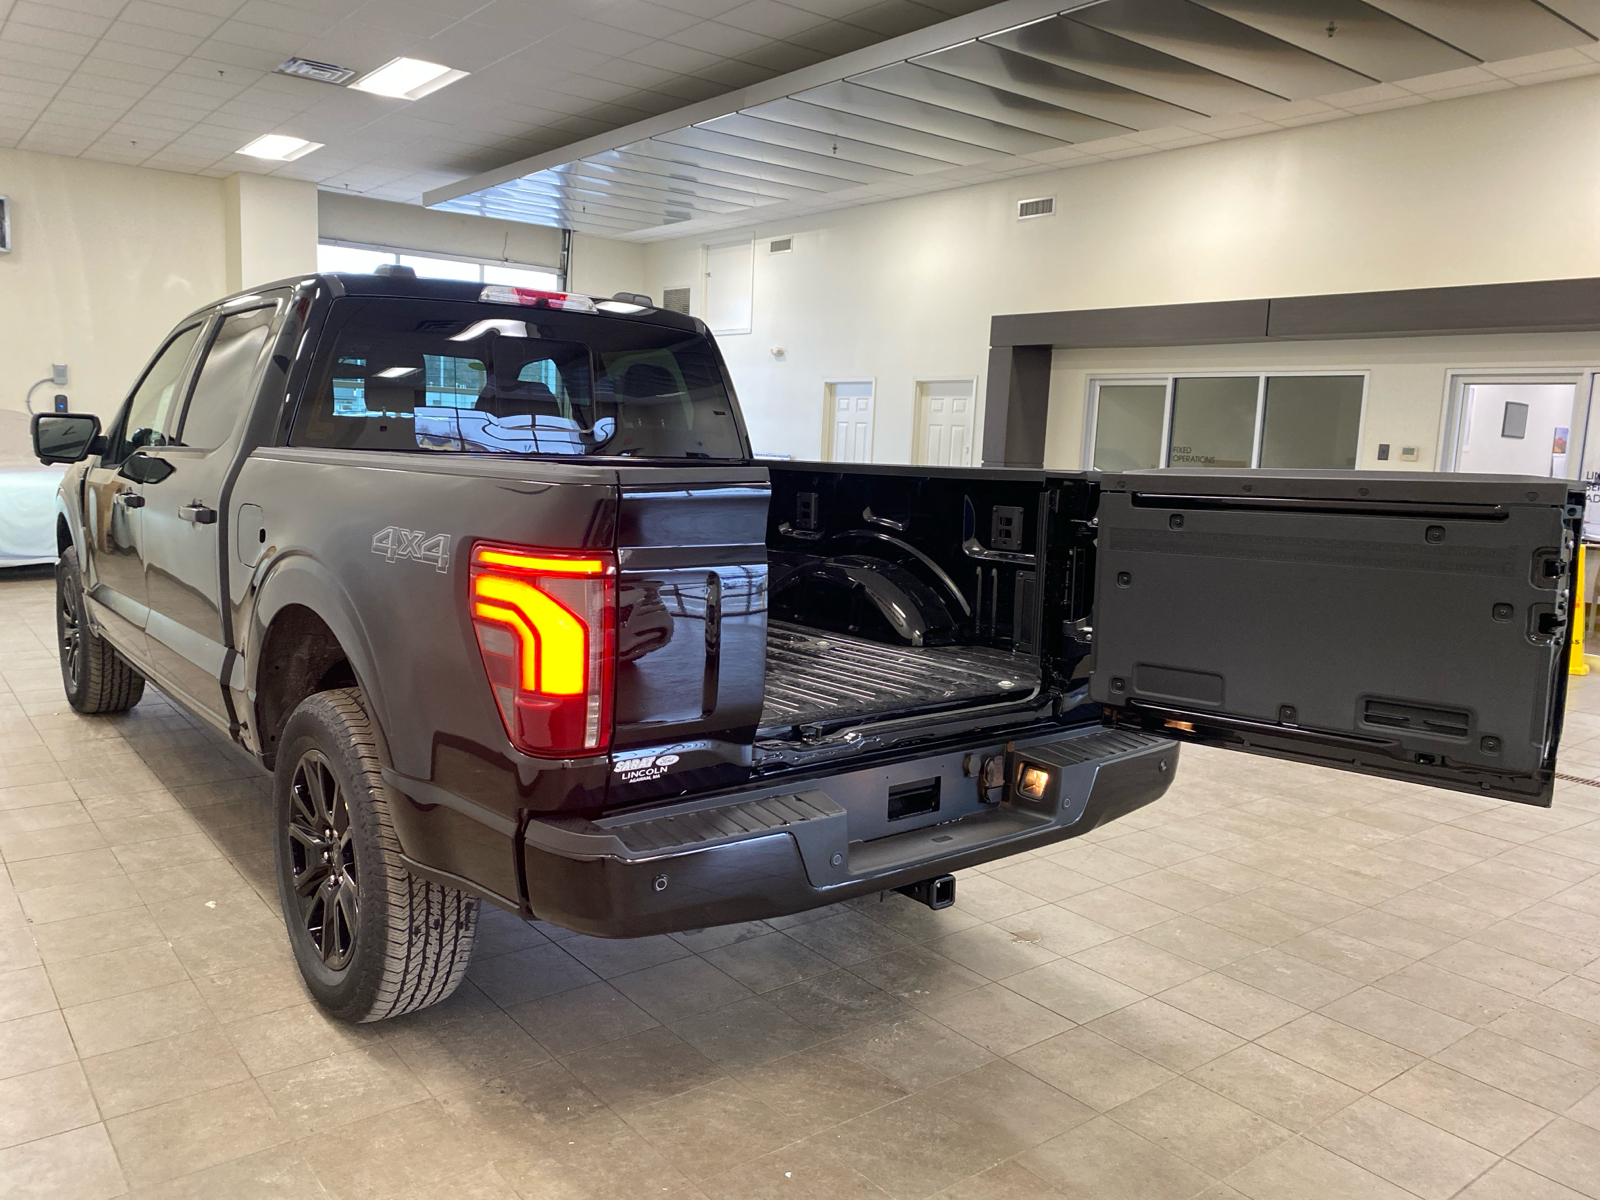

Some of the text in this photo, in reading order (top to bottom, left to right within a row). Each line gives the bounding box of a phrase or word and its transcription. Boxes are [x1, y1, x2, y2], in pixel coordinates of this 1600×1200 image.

[1173, 455, 1216, 464] OPERATIONS
[613, 756, 656, 773] SARAT
[621, 766, 668, 780] LINCOLN
